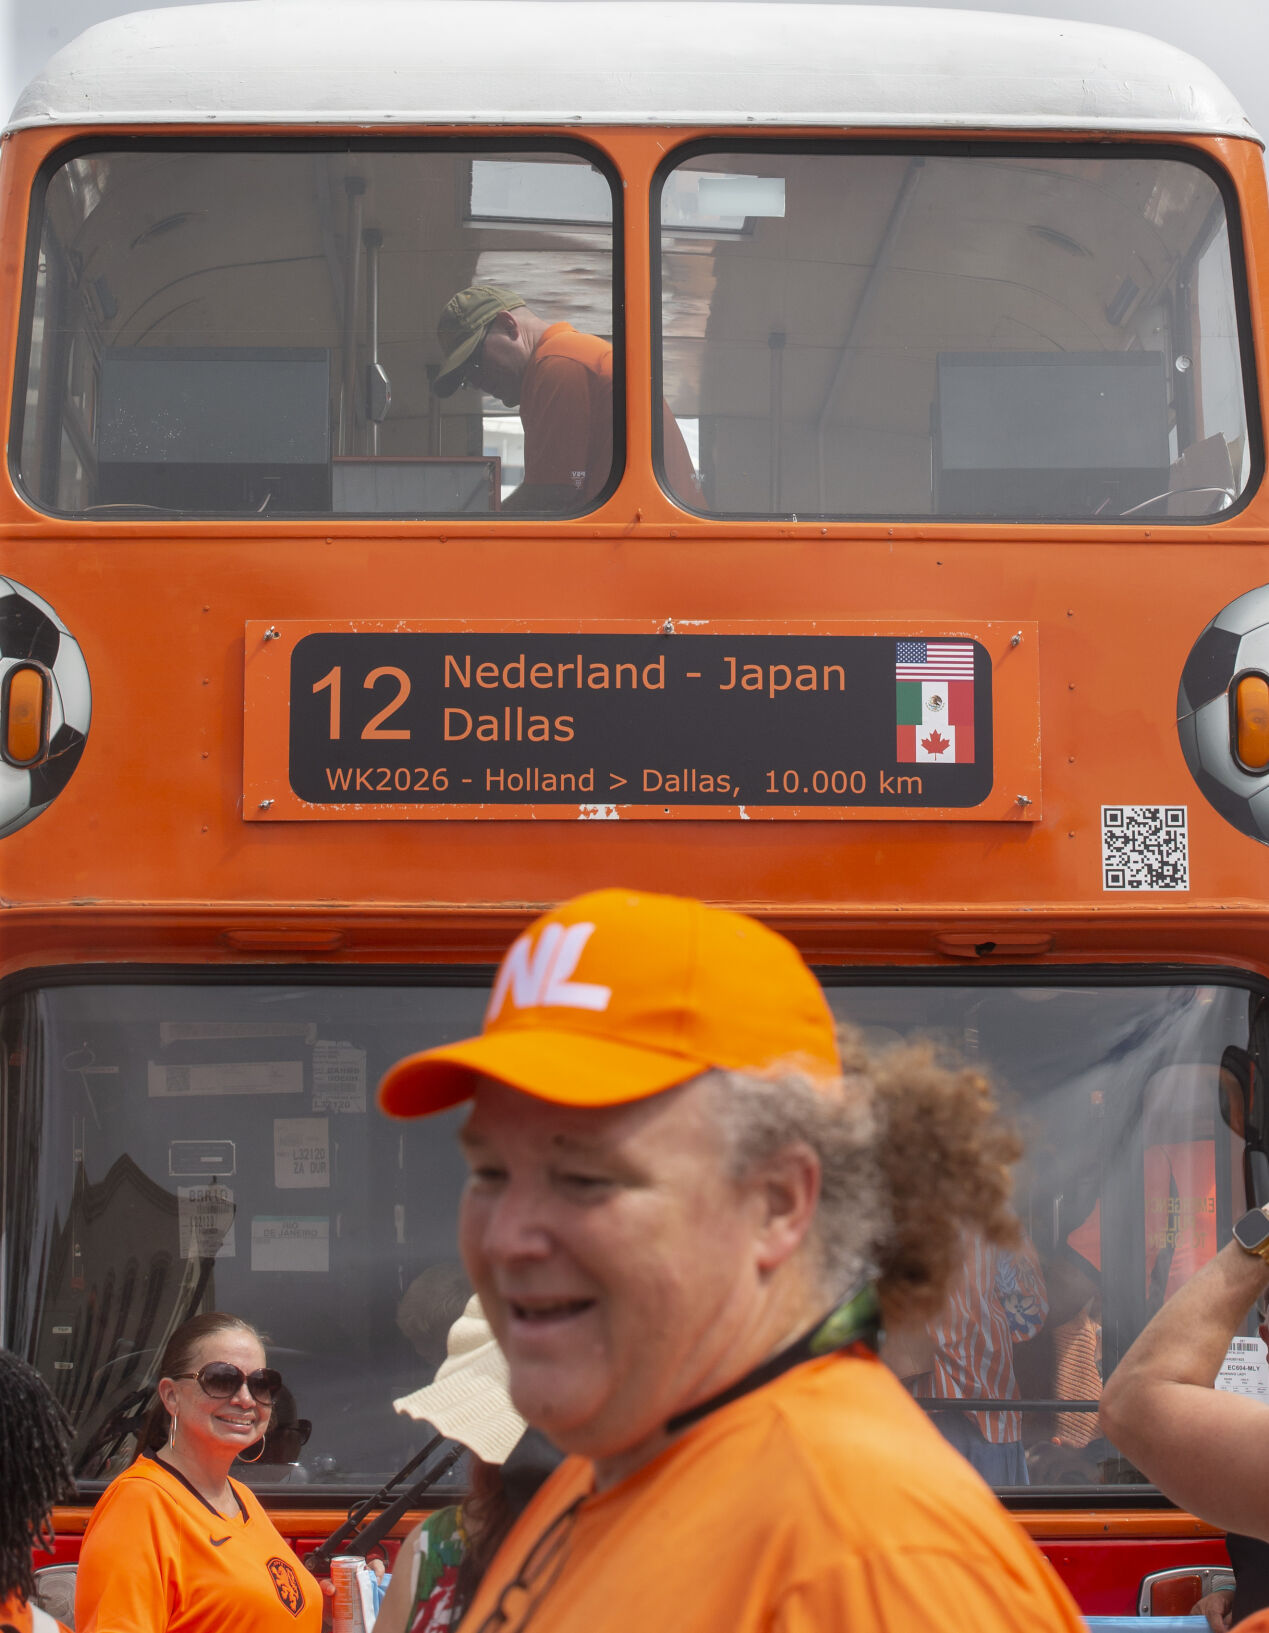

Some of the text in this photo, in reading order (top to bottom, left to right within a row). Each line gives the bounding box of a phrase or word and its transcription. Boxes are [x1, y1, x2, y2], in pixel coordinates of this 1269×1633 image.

[444, 653, 665, 690] Nederland
[719, 657, 846, 699] Japan
[312, 666, 412, 741] 12
[443, 706, 575, 742] Dallas
[326, 768, 449, 791] WK2026
[485, 768, 595, 792] Holland
[642, 768, 740, 798] Dallas,
[765, 770, 867, 794] 10.000
[879, 770, 923, 795] km
[487, 922, 612, 1023] NL
